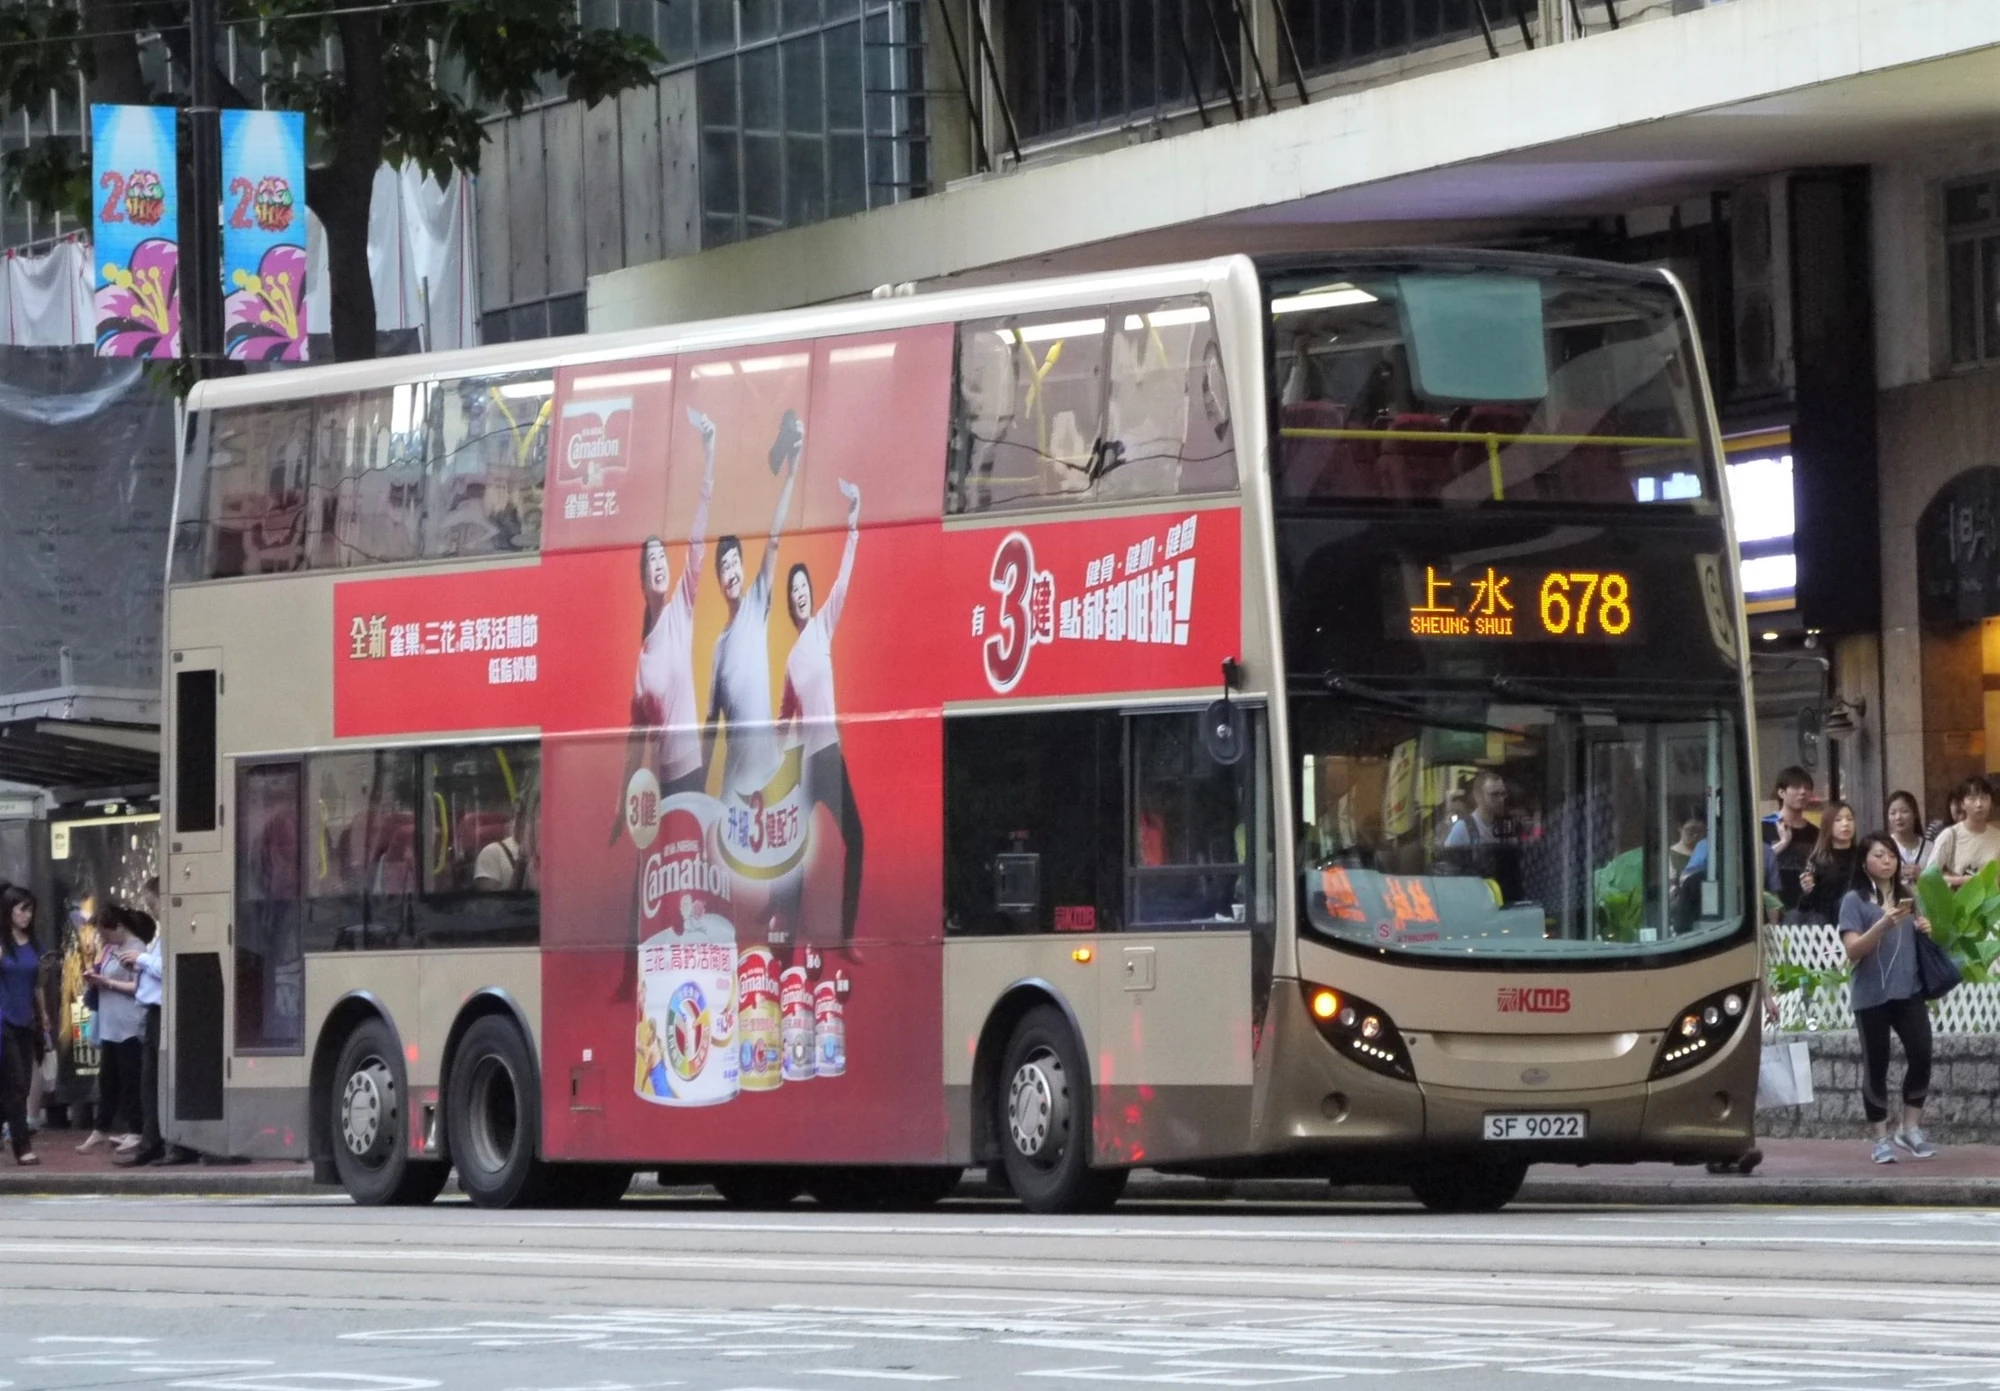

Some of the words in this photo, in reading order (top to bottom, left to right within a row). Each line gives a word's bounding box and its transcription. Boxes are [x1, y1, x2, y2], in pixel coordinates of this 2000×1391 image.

[567, 433, 620, 470] Carnation
[1410, 566, 1514, 615] 上水
[1540, 572, 1631, 635] 678
[1410, 616, 1470, 635] SHEUNG
[1475, 617, 1514, 636] SHUI
[488, 655, 538, 685] 低脂奶粉
[628, 790, 657, 828] 3健
[643, 852, 731, 919] Carnation
[1379, 923, 1390, 938] S
[738, 972, 779, 1003] Carnation
[1517, 988, 1571, 1014] KMB
[1492, 1117, 1518, 1137] SF
[1525, 1117, 1579, 1136] 9022
